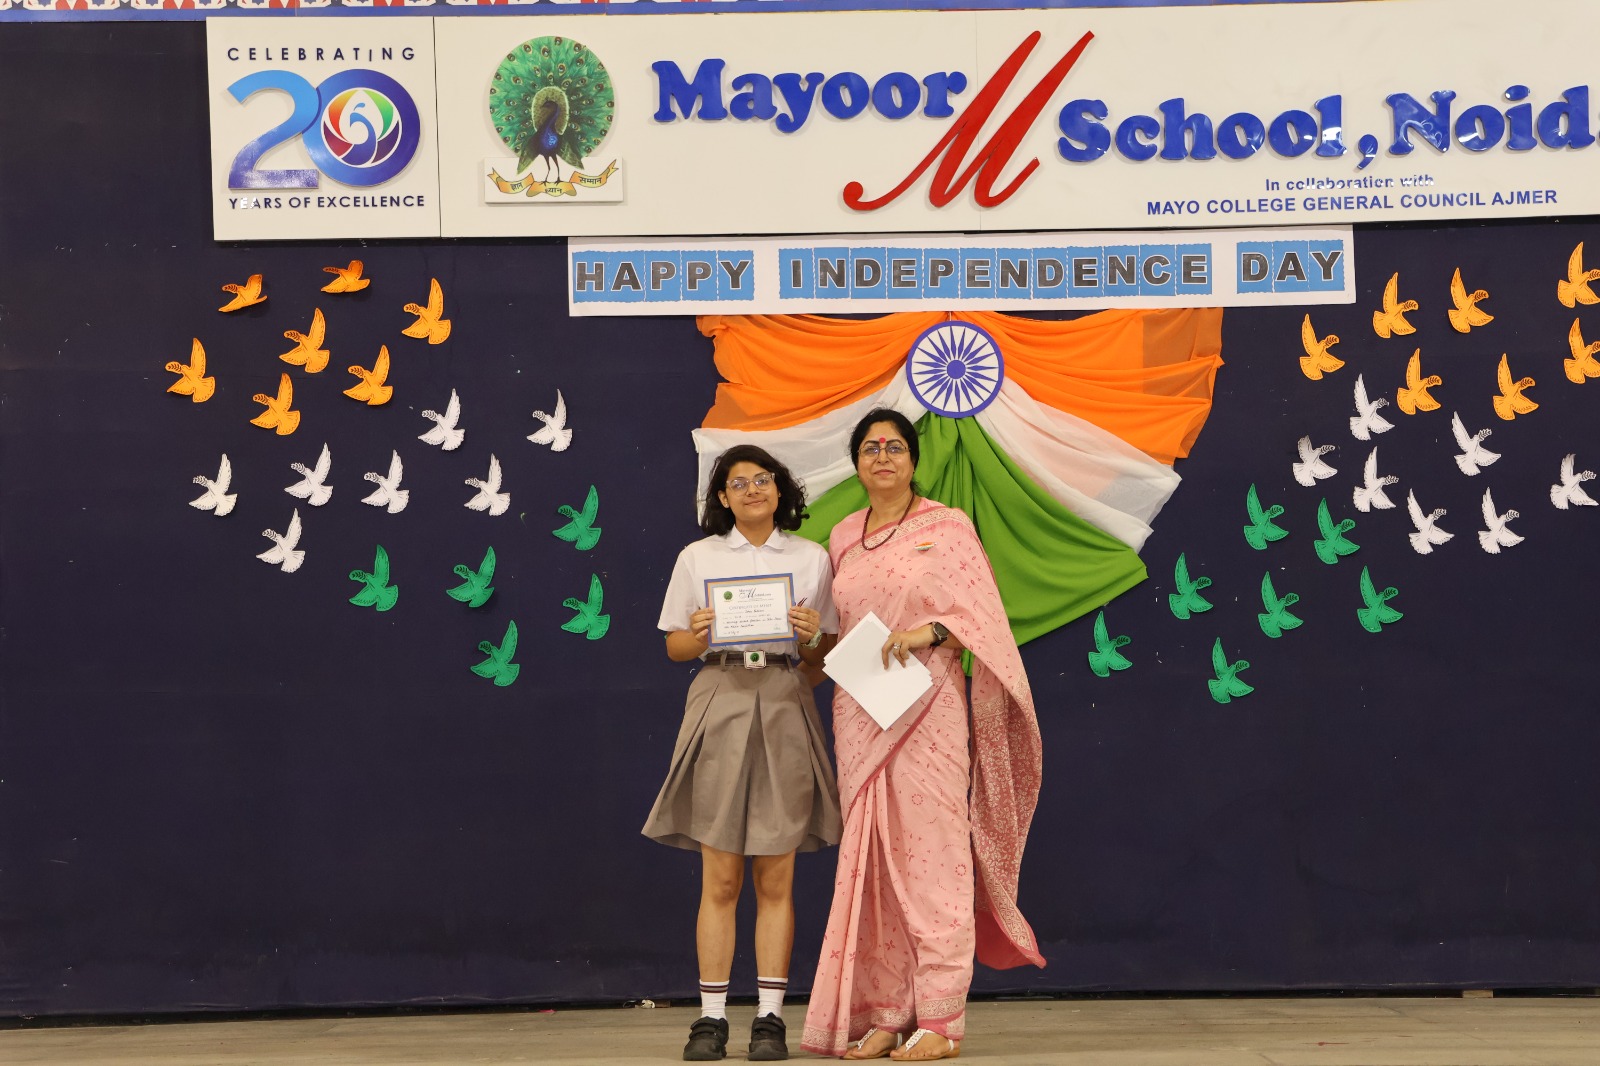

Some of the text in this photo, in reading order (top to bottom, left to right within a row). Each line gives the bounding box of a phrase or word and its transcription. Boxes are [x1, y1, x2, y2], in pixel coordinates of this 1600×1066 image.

[227, 47, 415, 61] CELEBRATING
[652, 58, 967, 133] Mayoor
[1386, 84, 1600, 155] Noid
[579, 175, 602, 185] सम्मान
[1265, 174, 1434, 191] In collaboration with
[229, 195, 425, 209] YEARS OF EXCELLENCE
[1147, 189, 1558, 215] MAYO COLLEGE GENERAL COUNCIL AJMER
[574, 248, 1343, 292] HAPPY INDEPENDENCE DAY
